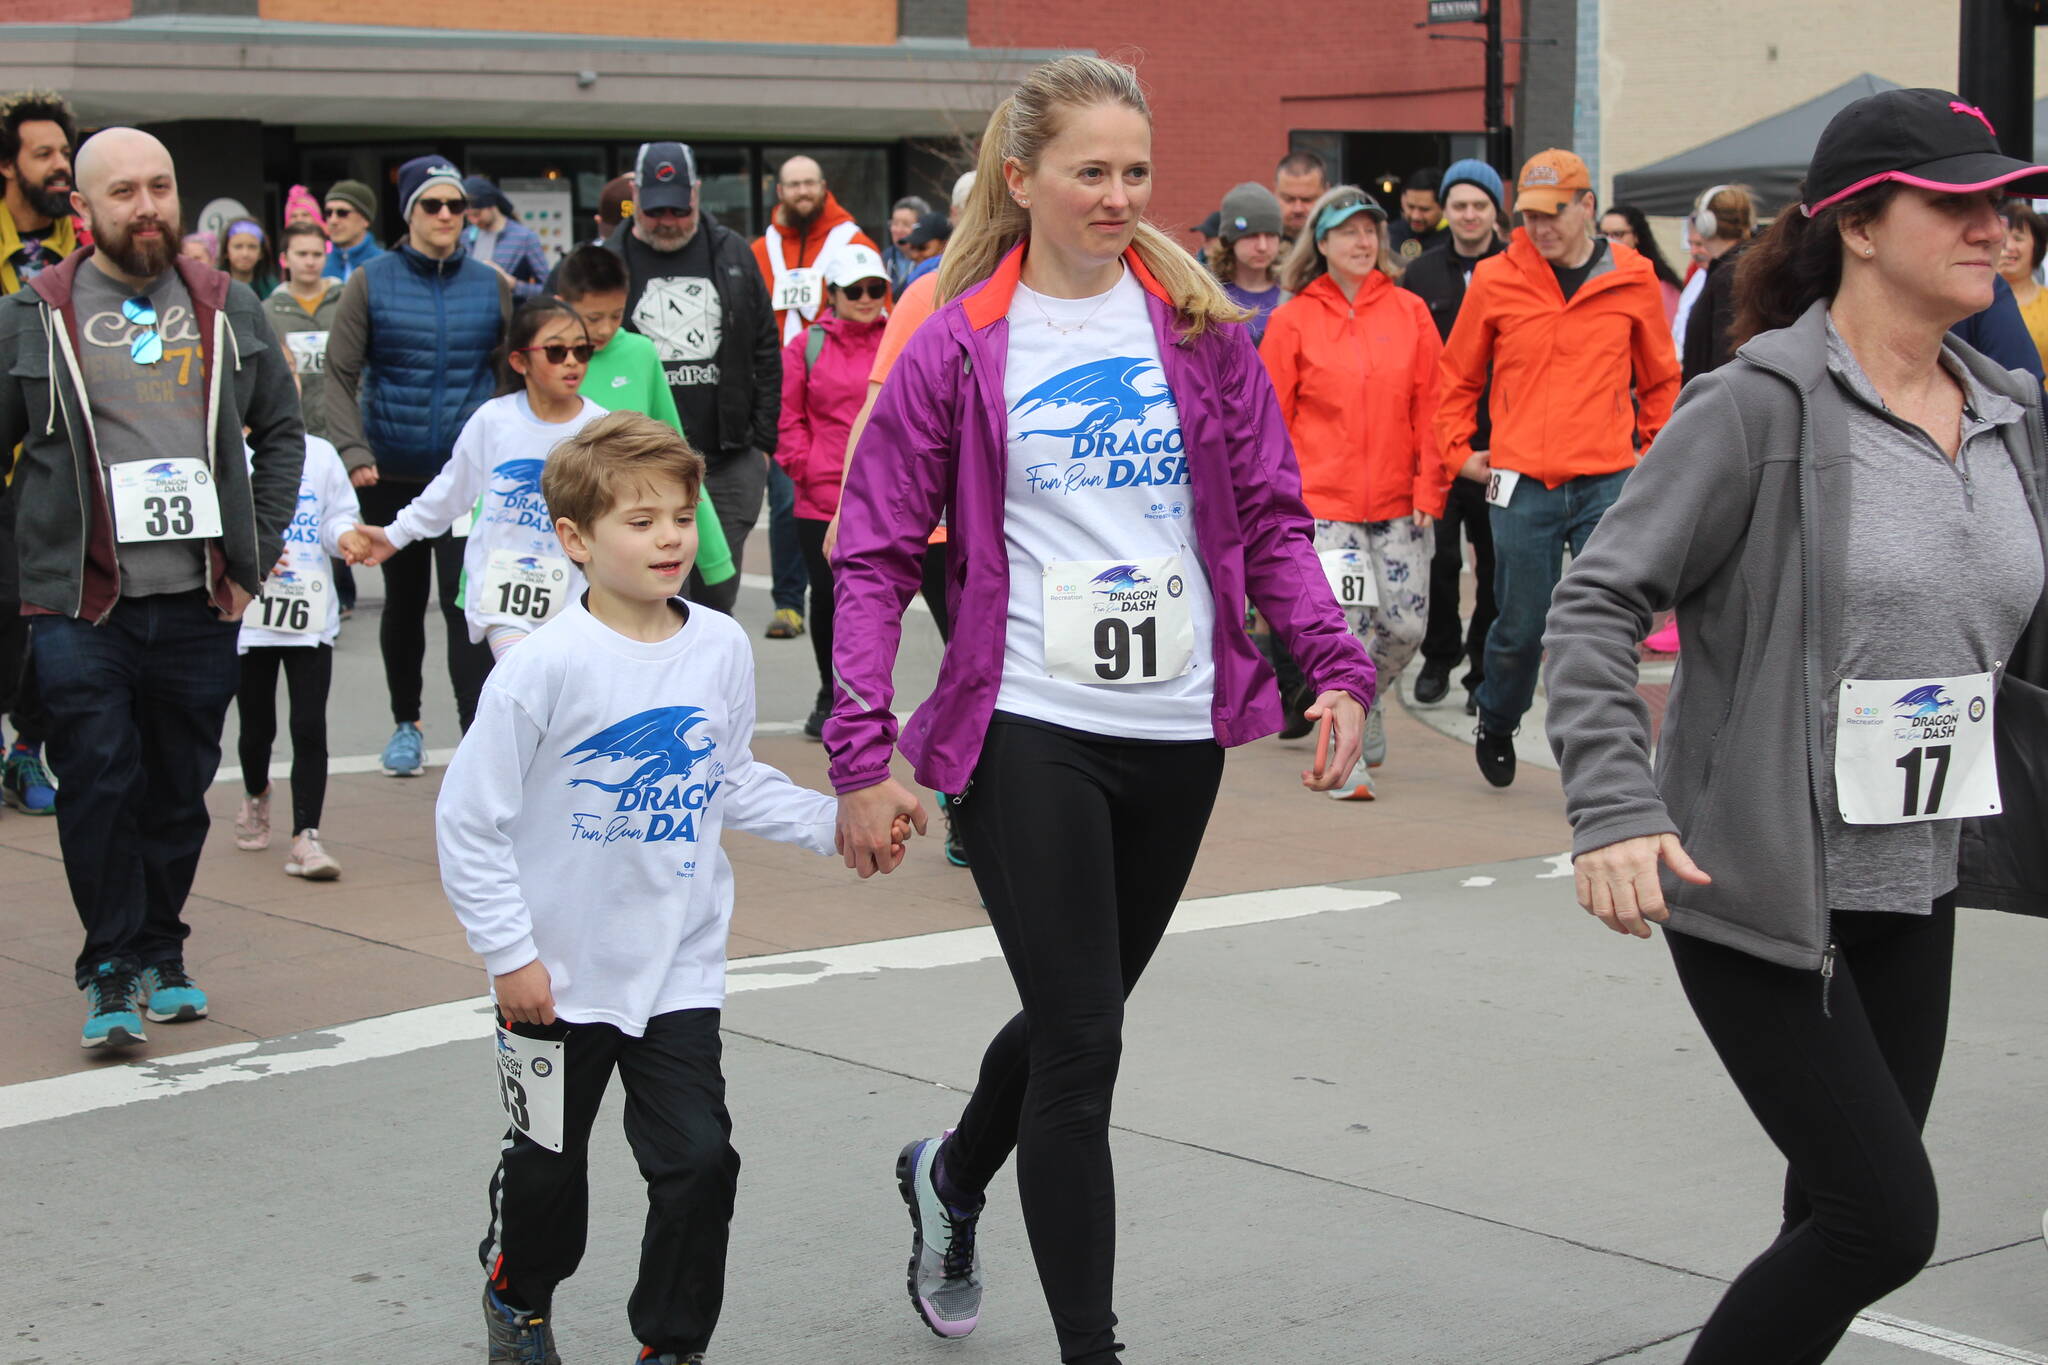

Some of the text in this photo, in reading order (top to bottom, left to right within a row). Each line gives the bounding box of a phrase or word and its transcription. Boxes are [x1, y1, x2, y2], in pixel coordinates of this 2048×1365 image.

[783, 286, 811, 304] 126
[1070, 428, 1188, 459] DRAGO
[155, 479, 188, 487] DRAGON
[1026, 456, 1192, 495] Fun Run DASH
[144, 495, 193, 536] 33
[517, 511, 557, 533] DAS
[283, 527, 320, 544] DAS
[498, 581, 551, 619] 195
[1109, 590, 1158, 601] DRAGON
[1342, 575, 1364, 601] 87
[262, 596, 310, 630] 176
[1121, 600, 1156, 612] DASH
[1094, 616, 1157, 680] 91
[1846, 718, 1884, 726] Recreation
[1912, 714, 1959, 727] DRAGON
[1922, 725, 1956, 740] DASH
[1896, 744, 1951, 817] 17
[615, 780, 721, 812] DRAGN
[571, 806, 707, 848] Fun Run DA
